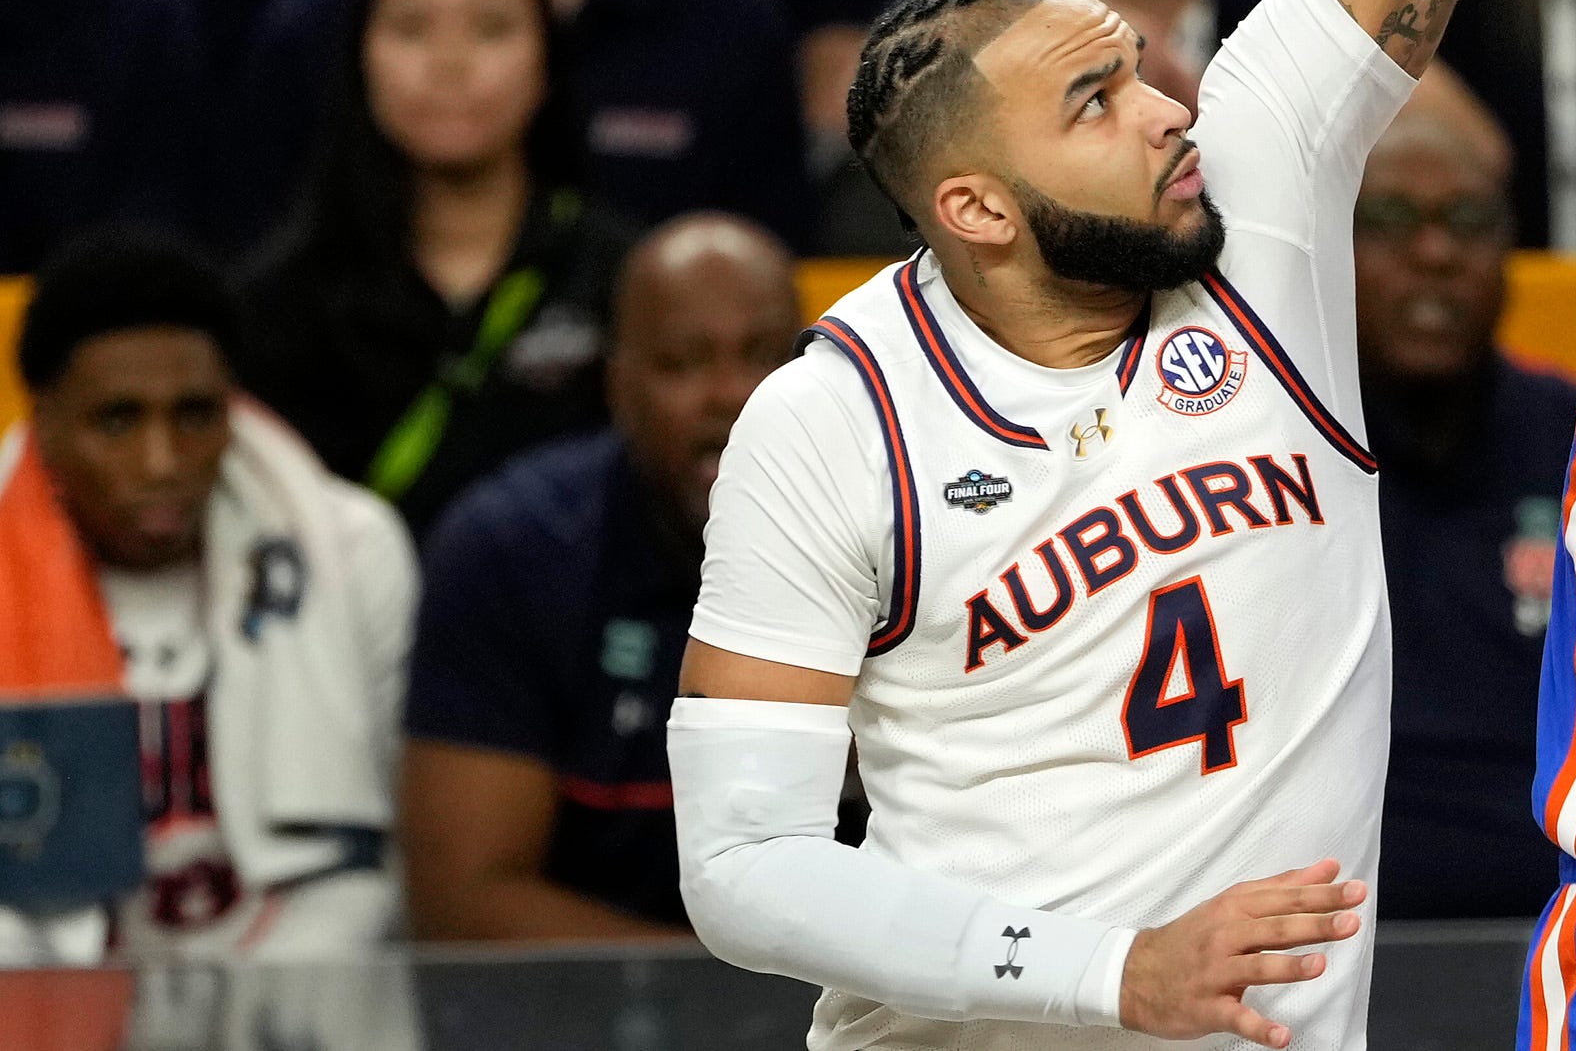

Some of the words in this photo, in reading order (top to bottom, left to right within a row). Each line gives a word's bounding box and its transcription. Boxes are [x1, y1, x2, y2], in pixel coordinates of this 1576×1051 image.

[1161, 331, 1224, 393] SEC
[1175, 370, 1242, 412] GRADUATE
[947, 486, 979, 499] FINAL
[980, 483, 1010, 496] FOUR
[965, 453, 1325, 674] AUBURN
[1120, 574, 1249, 776] 4
